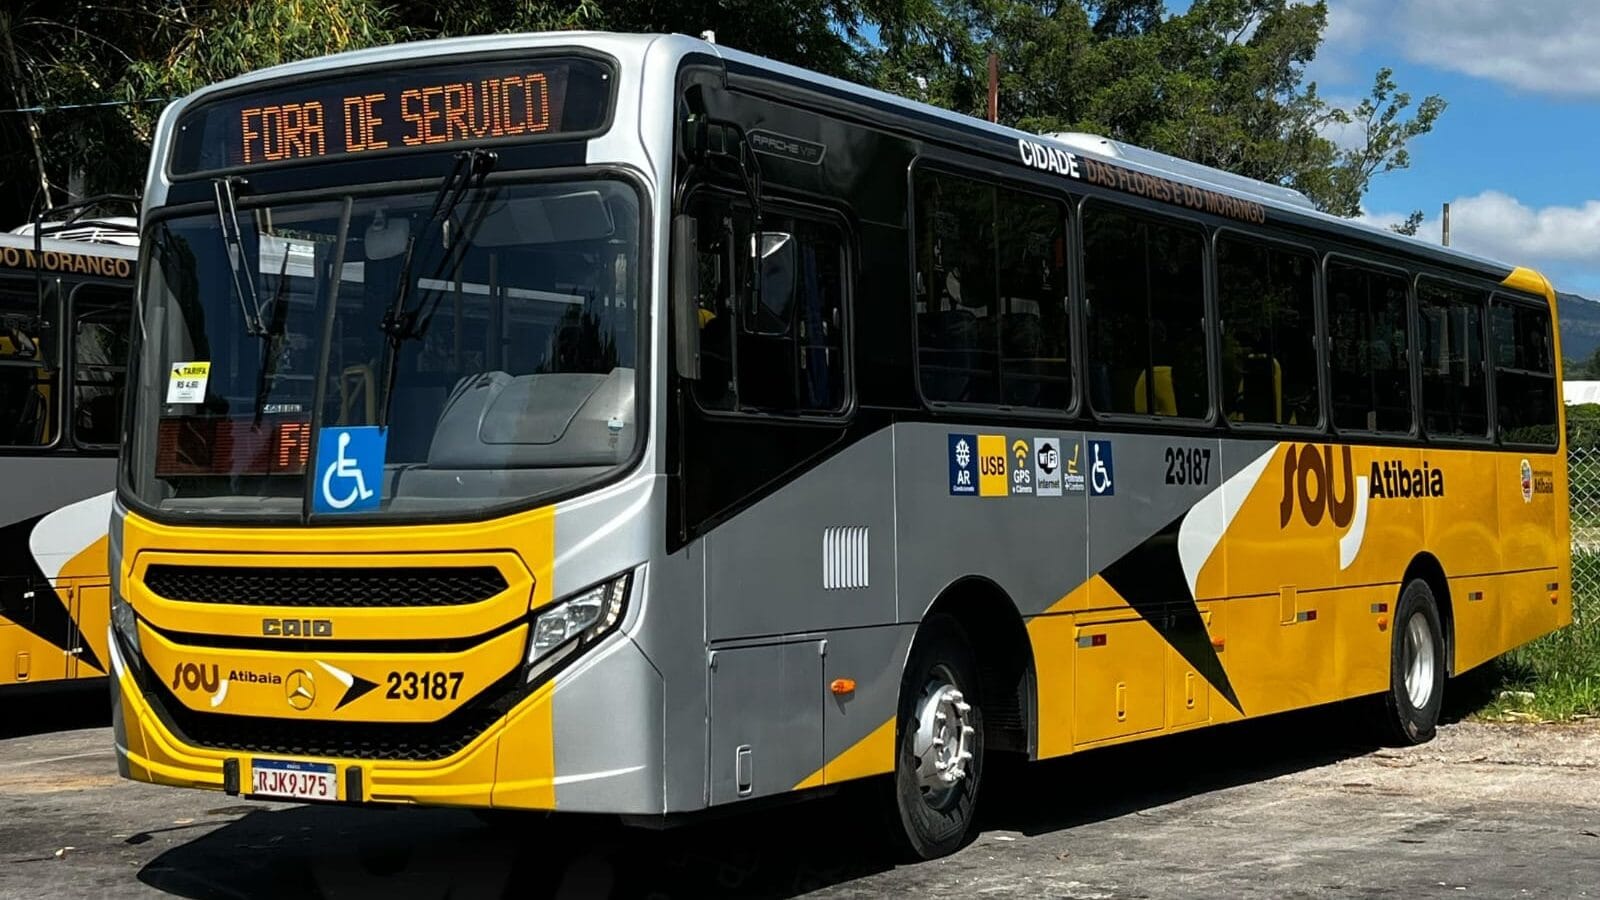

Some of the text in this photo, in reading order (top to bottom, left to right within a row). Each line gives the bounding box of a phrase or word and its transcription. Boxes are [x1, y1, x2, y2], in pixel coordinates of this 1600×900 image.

[241, 72, 549, 163] FORA DE SERVICO
[1018, 138, 1266, 225] CIDADE DAS FLORES E DO MORANGO
[0, 247, 130, 278] O MORANGO
[957, 470, 971, 485] AR
[981, 456, 1005, 476] USB
[1013, 469, 1031, 484] GPS
[1165, 447, 1211, 486] 23187
[1038, 479, 1060, 489] Internet
[1369, 460, 1444, 499] Atibaia
[262, 618, 333, 637] CAIO
[228, 669, 282, 685] Atibaia
[386, 671, 464, 701] 23187
[259, 771, 327, 796] RJK9J75
